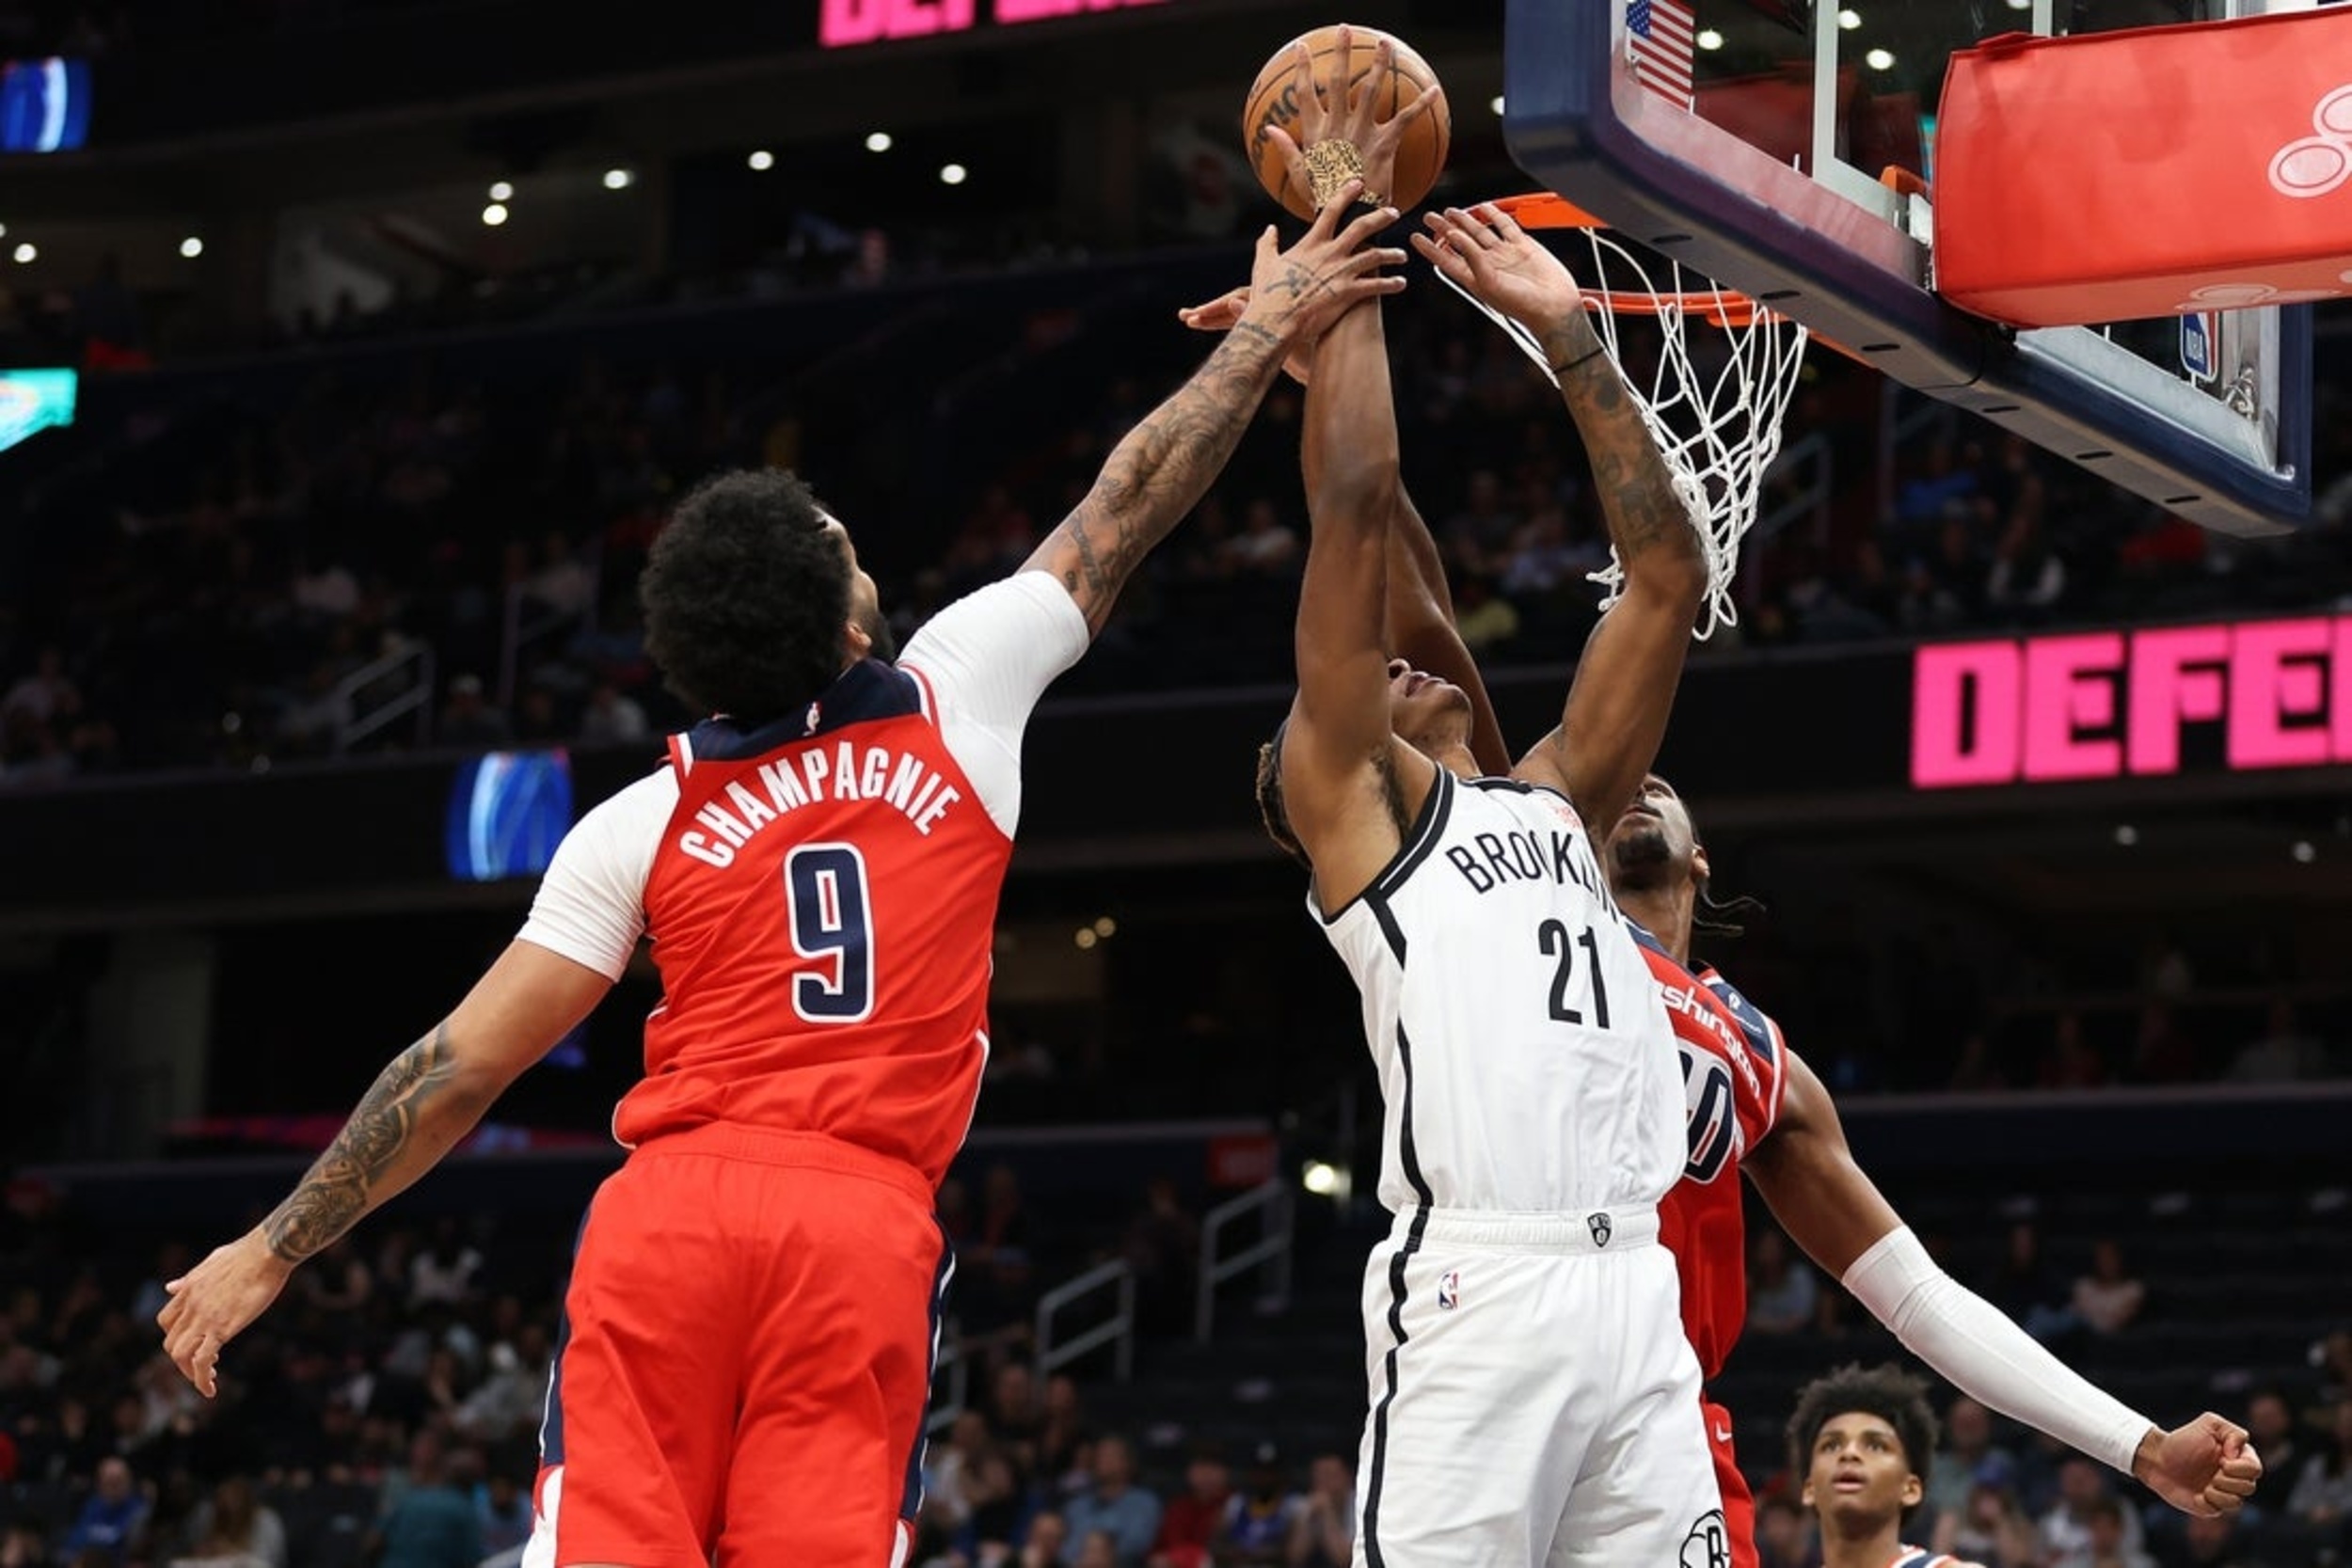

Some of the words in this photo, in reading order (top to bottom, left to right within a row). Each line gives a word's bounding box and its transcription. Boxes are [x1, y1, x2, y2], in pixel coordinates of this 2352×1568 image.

[1910, 615, 2352, 790] DEFE
[679, 740, 961, 868] CHAMPAGNIE
[783, 841, 875, 1024] 9
[1538, 918, 1610, 1030] 21
[1656, 981, 1762, 1100] shington
[1678, 1038, 1736, 1185] 0
